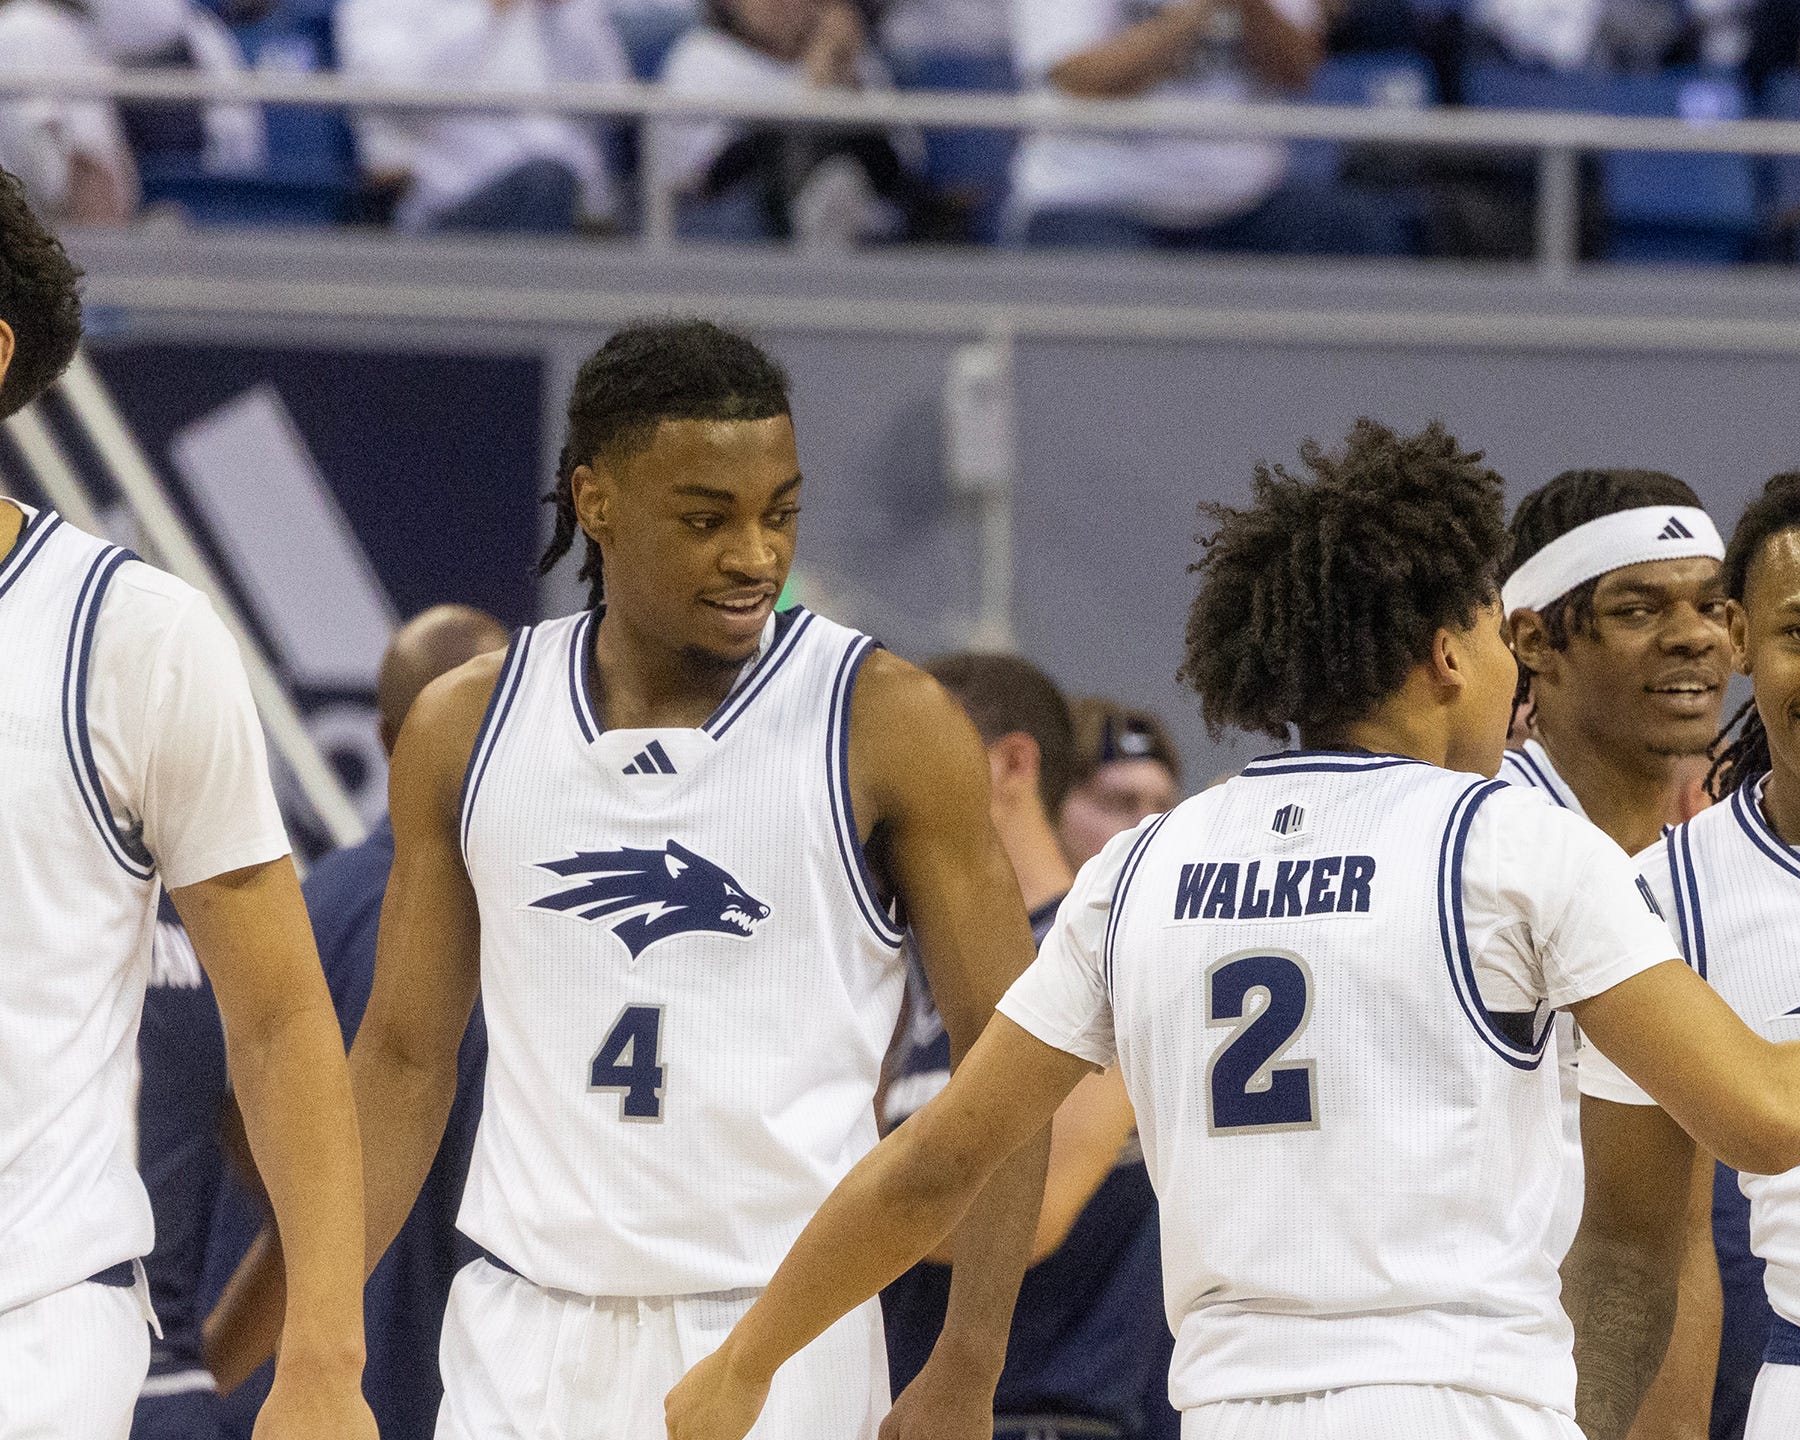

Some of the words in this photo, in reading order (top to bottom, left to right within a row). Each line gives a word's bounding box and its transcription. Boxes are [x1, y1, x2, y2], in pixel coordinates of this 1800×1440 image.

[1173, 855, 1376, 920] WALKER
[587, 1002, 668, 1124] 4
[1204, 947, 1321, 1138] 2
